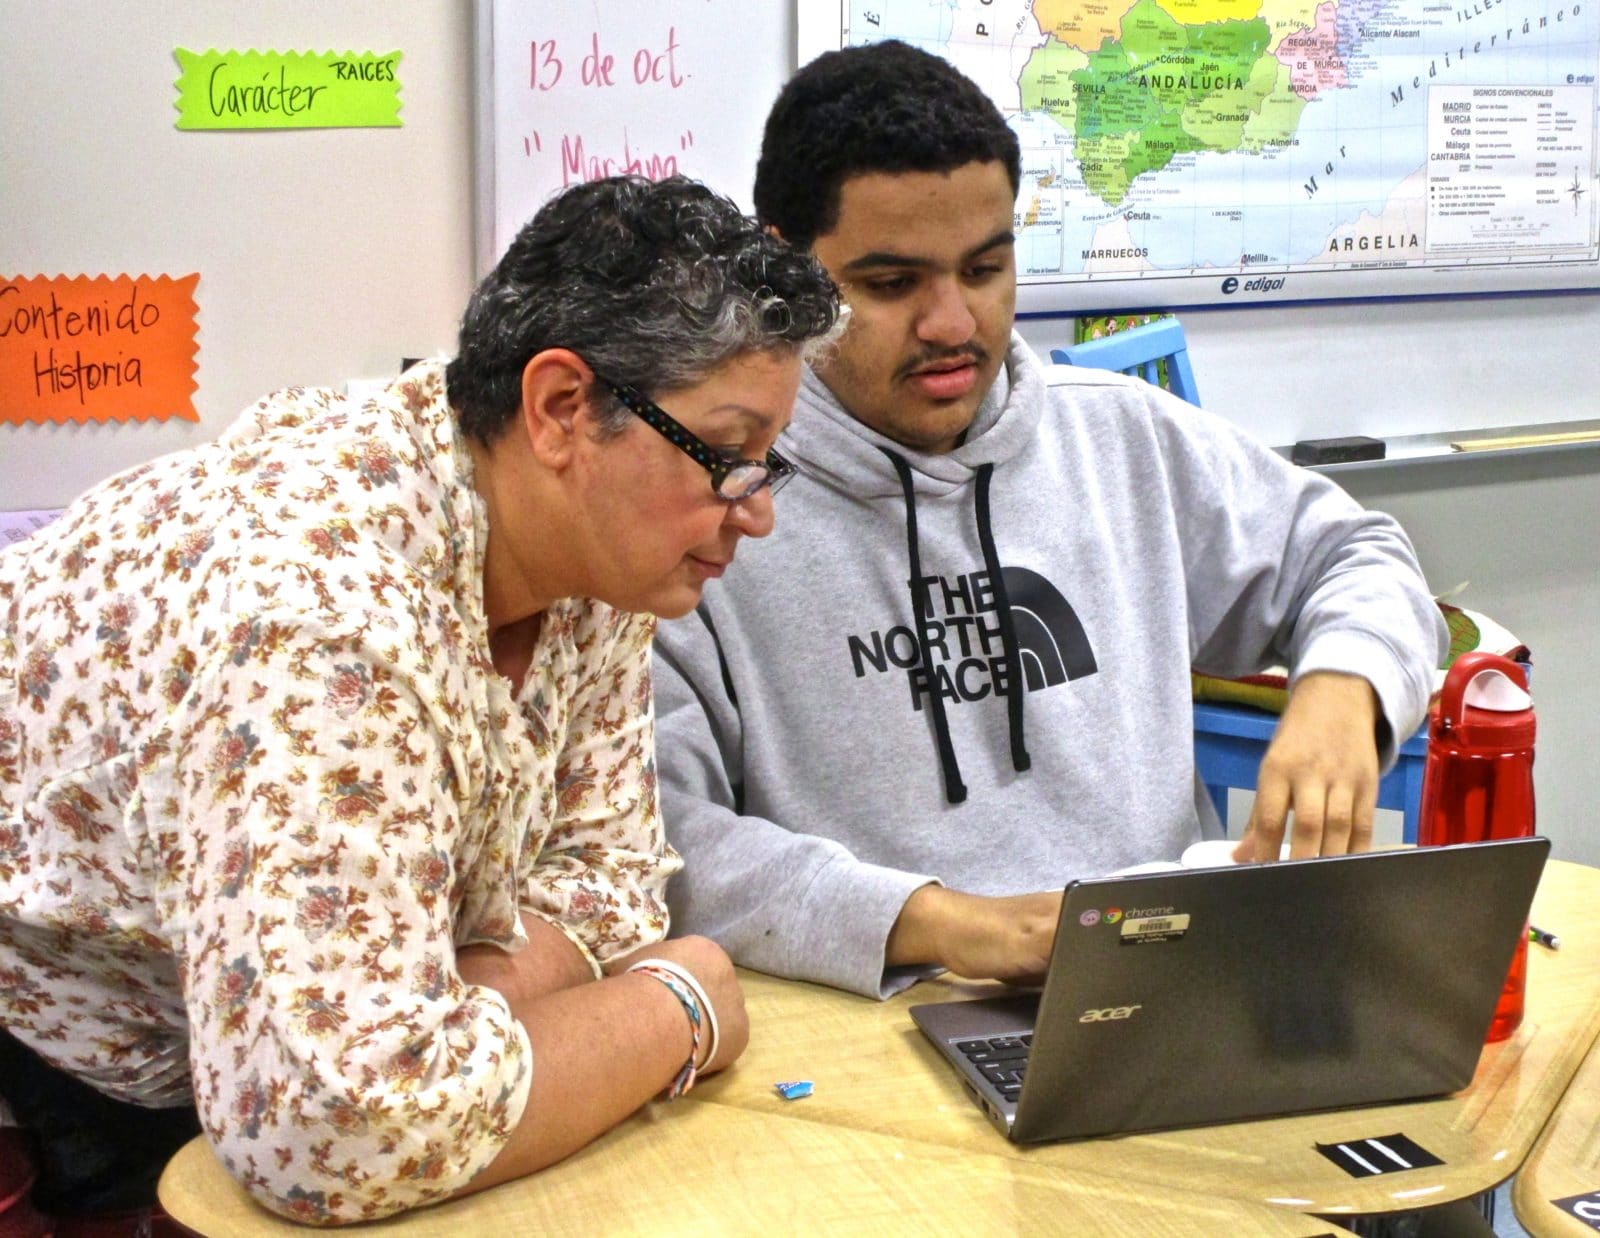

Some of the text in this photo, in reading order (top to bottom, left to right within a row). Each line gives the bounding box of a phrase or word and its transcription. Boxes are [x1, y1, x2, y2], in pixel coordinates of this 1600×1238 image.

[1288, 37, 1317, 47] REGIÓN
[530, 26, 692, 91] 13 de oct.
[1160, 55, 1195, 65] Córdoba
[1200, 62, 1220, 72] Jaén
[1297, 62, 1308, 70] DE
[1314, 60, 1344, 69] MURCIA
[328, 60, 394, 81] RAICES
[1138, 73, 1244, 90] ANDALUCÍA
[209, 62, 327, 117] Carácter
[1072, 84, 1106, 95] SEVILLA
[1288, 84, 1317, 93] MURCIA
[1473, 89, 1553, 97] SIGNOS CONVENCIONALES
[1041, 97, 1070, 108] Huelva
[1442, 102, 1471, 111] MADRID
[1215, 112, 1249, 122] Granada
[1444, 115, 1471, 124] MURCIA
[1451, 127, 1471, 136] Ceuta
[1145, 140, 1174, 151] Málaga
[1446, 141, 1470, 150] Málaga
[1431, 153, 1471, 161] CANTABRIA
[1080, 161, 1103, 171] Cádiz
[1304, 145, 1346, 200] Mar
[1127, 211, 1151, 221] Ceuta
[1329, 234, 1419, 252] ARGELIA
[1082, 248, 1148, 260] MARRUECOS
[1243, 254, 1268, 263] Melilla
[1244, 276, 1286, 293] edigol
[0, 285, 160, 340] Contenido
[34, 347, 143, 405] Historia
[907, 570, 998, 619] THE
[847, 615, 1007, 678] NORTH
[907, 656, 1011, 712] FACE
[1125, 905, 1174, 919] chrome
[1079, 1004, 1142, 1023] acer
